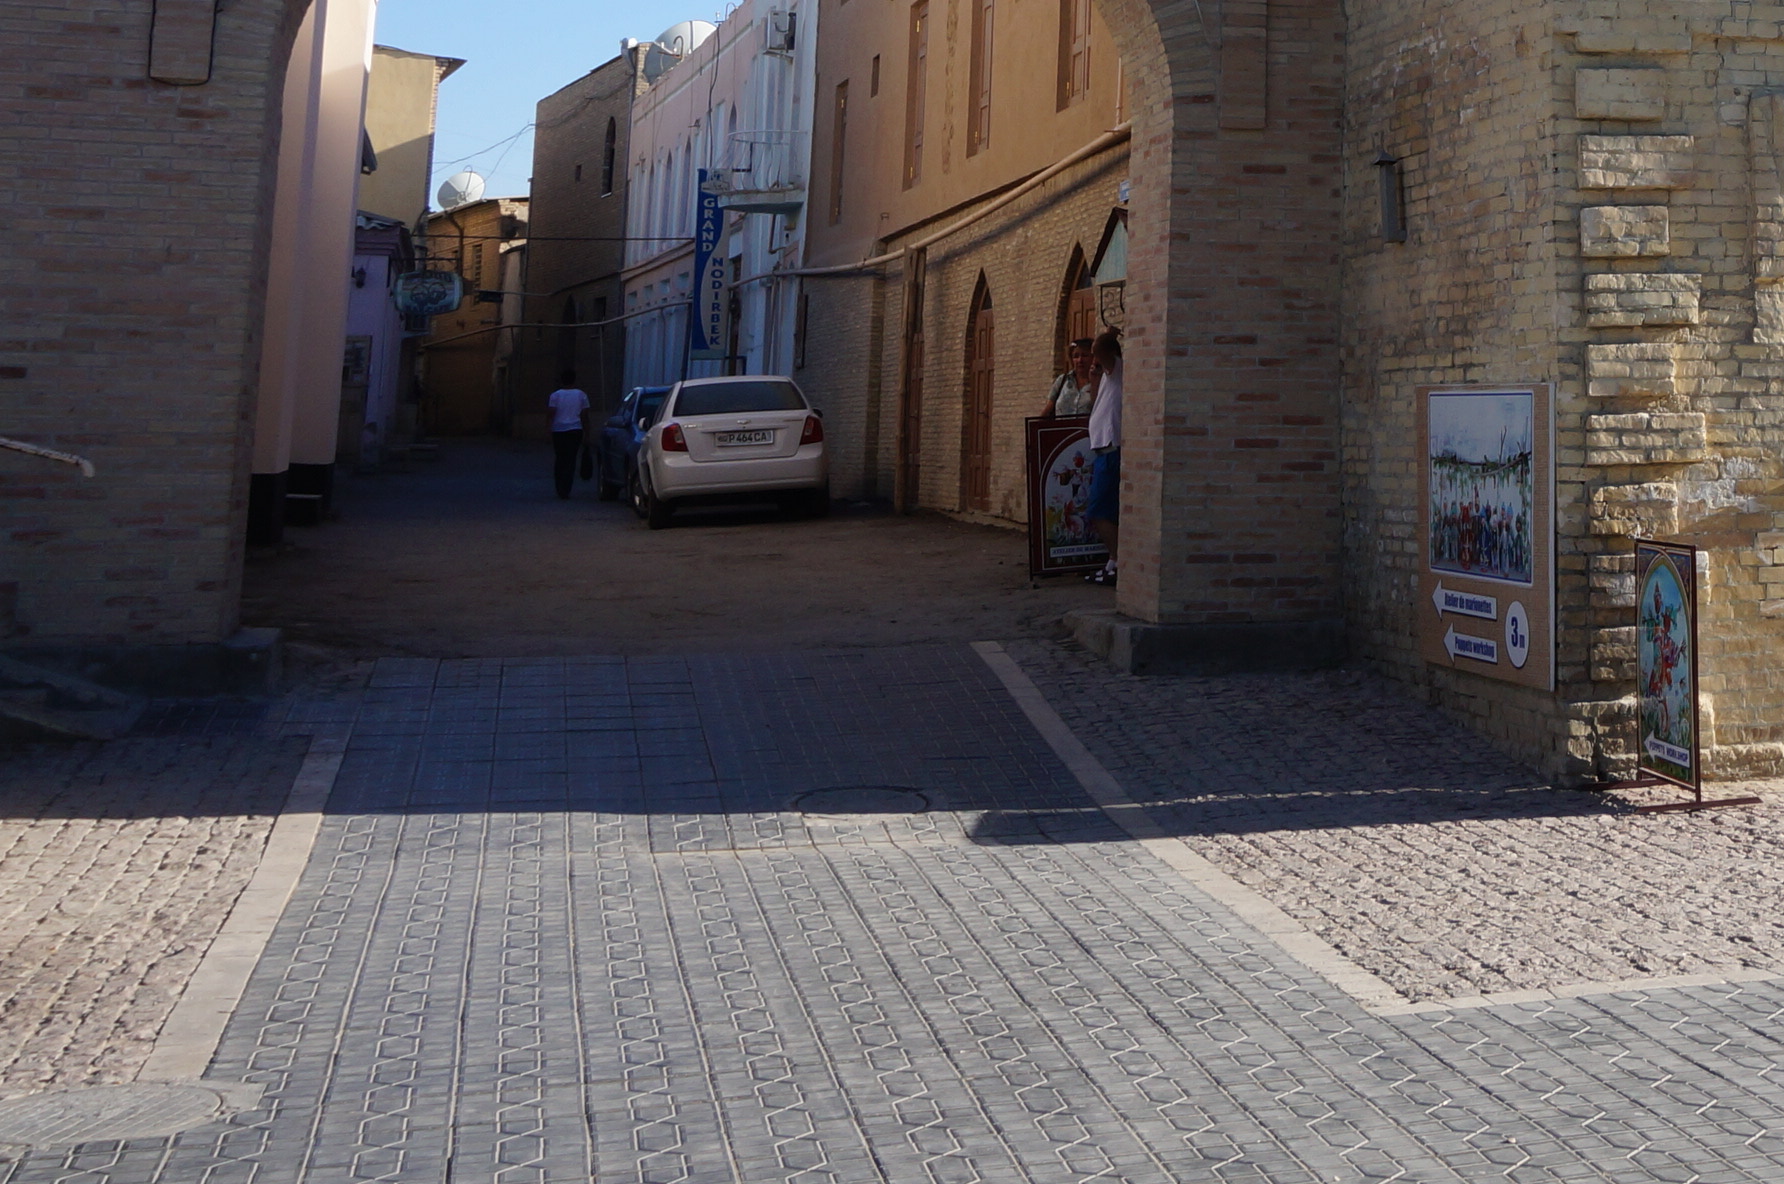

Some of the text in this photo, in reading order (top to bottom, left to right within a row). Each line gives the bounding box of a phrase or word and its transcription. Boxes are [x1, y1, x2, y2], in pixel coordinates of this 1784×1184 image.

[702, 197, 716, 252] GRAND
[709, 257, 724, 346] NODIRBEK
[1455, 636, 1494, 658] Puppets workshop
